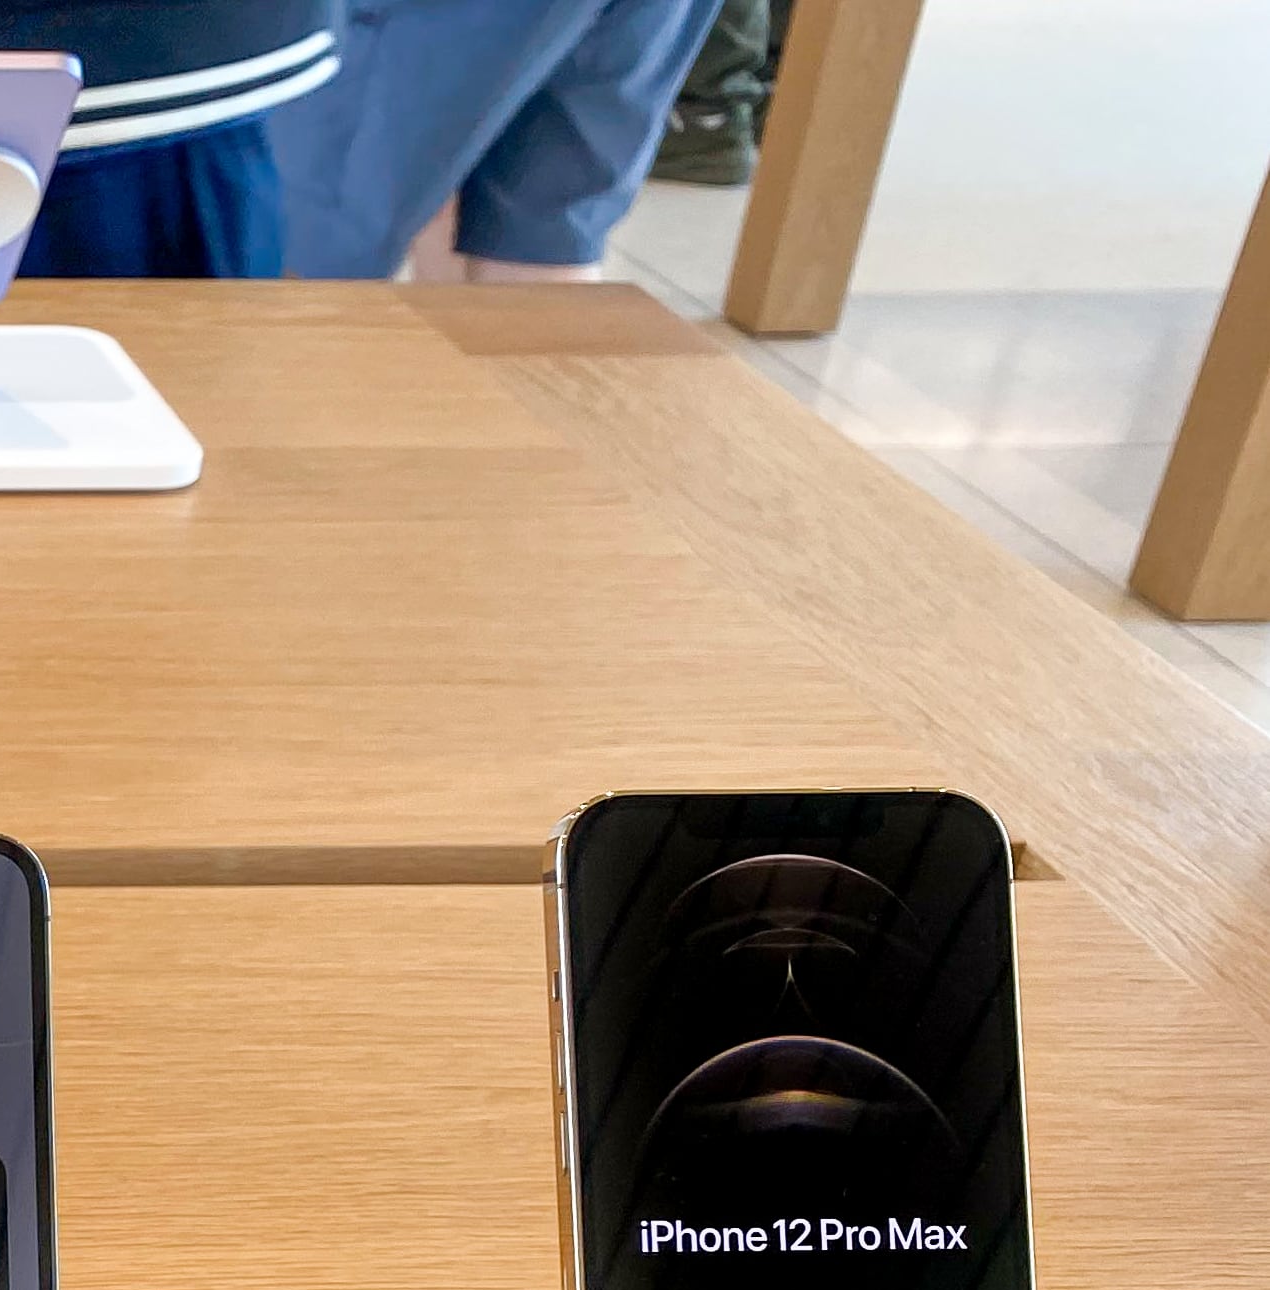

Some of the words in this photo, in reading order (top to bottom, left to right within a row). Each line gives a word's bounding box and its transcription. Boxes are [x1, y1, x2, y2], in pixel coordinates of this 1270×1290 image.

[641, 1220, 767, 1252] iPhone
[773, 1219, 813, 1251] 12
[821, 1219, 884, 1251] Pro
[889, 1219, 968, 1250] Max
